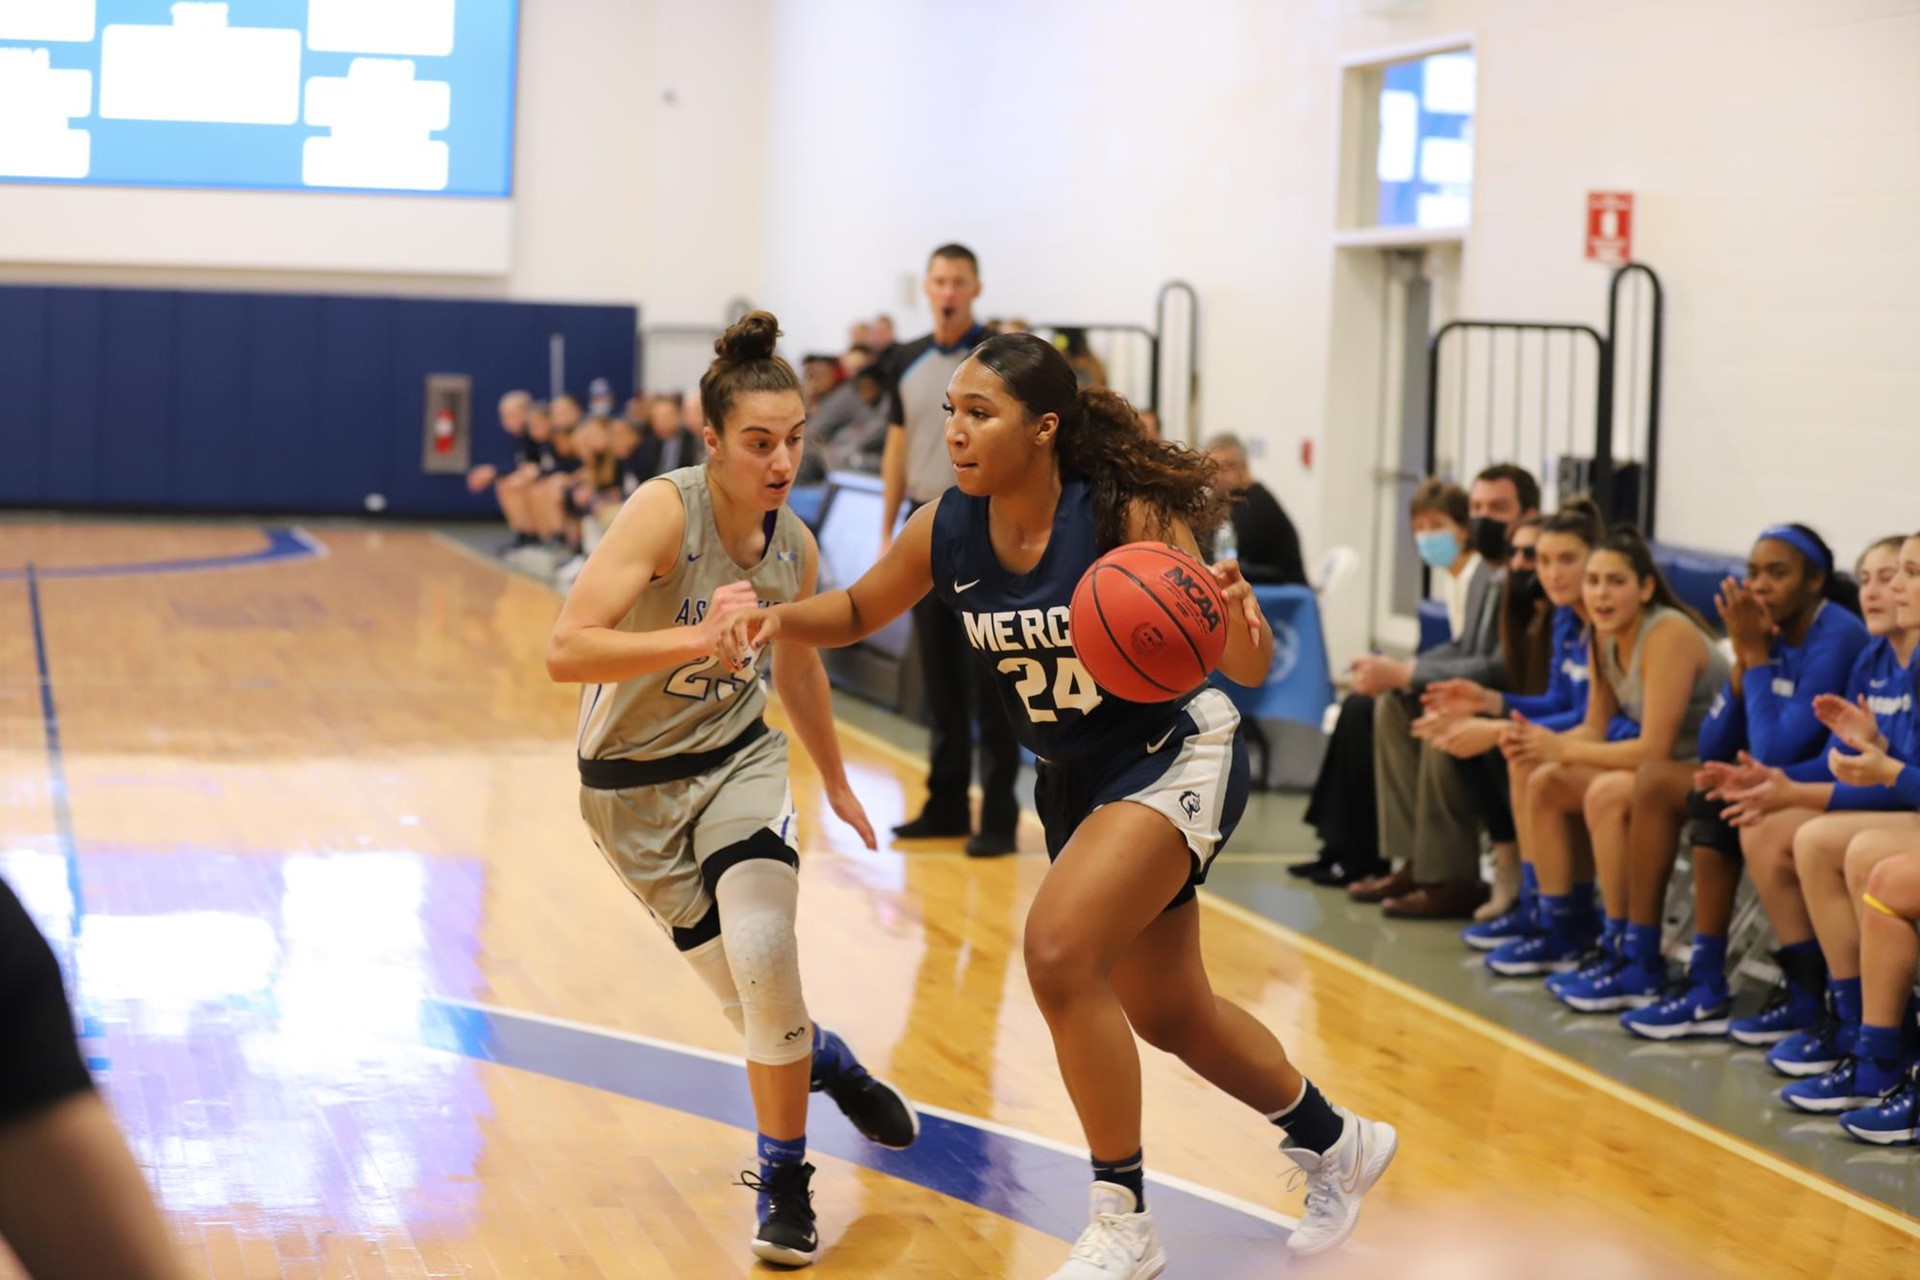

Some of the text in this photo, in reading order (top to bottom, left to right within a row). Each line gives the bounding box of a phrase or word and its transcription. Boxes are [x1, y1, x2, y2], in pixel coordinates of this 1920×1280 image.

[962, 605, 1073, 652] MERC
[1164, 566, 1221, 633] NCAA
[997, 657, 1103, 723] 24
